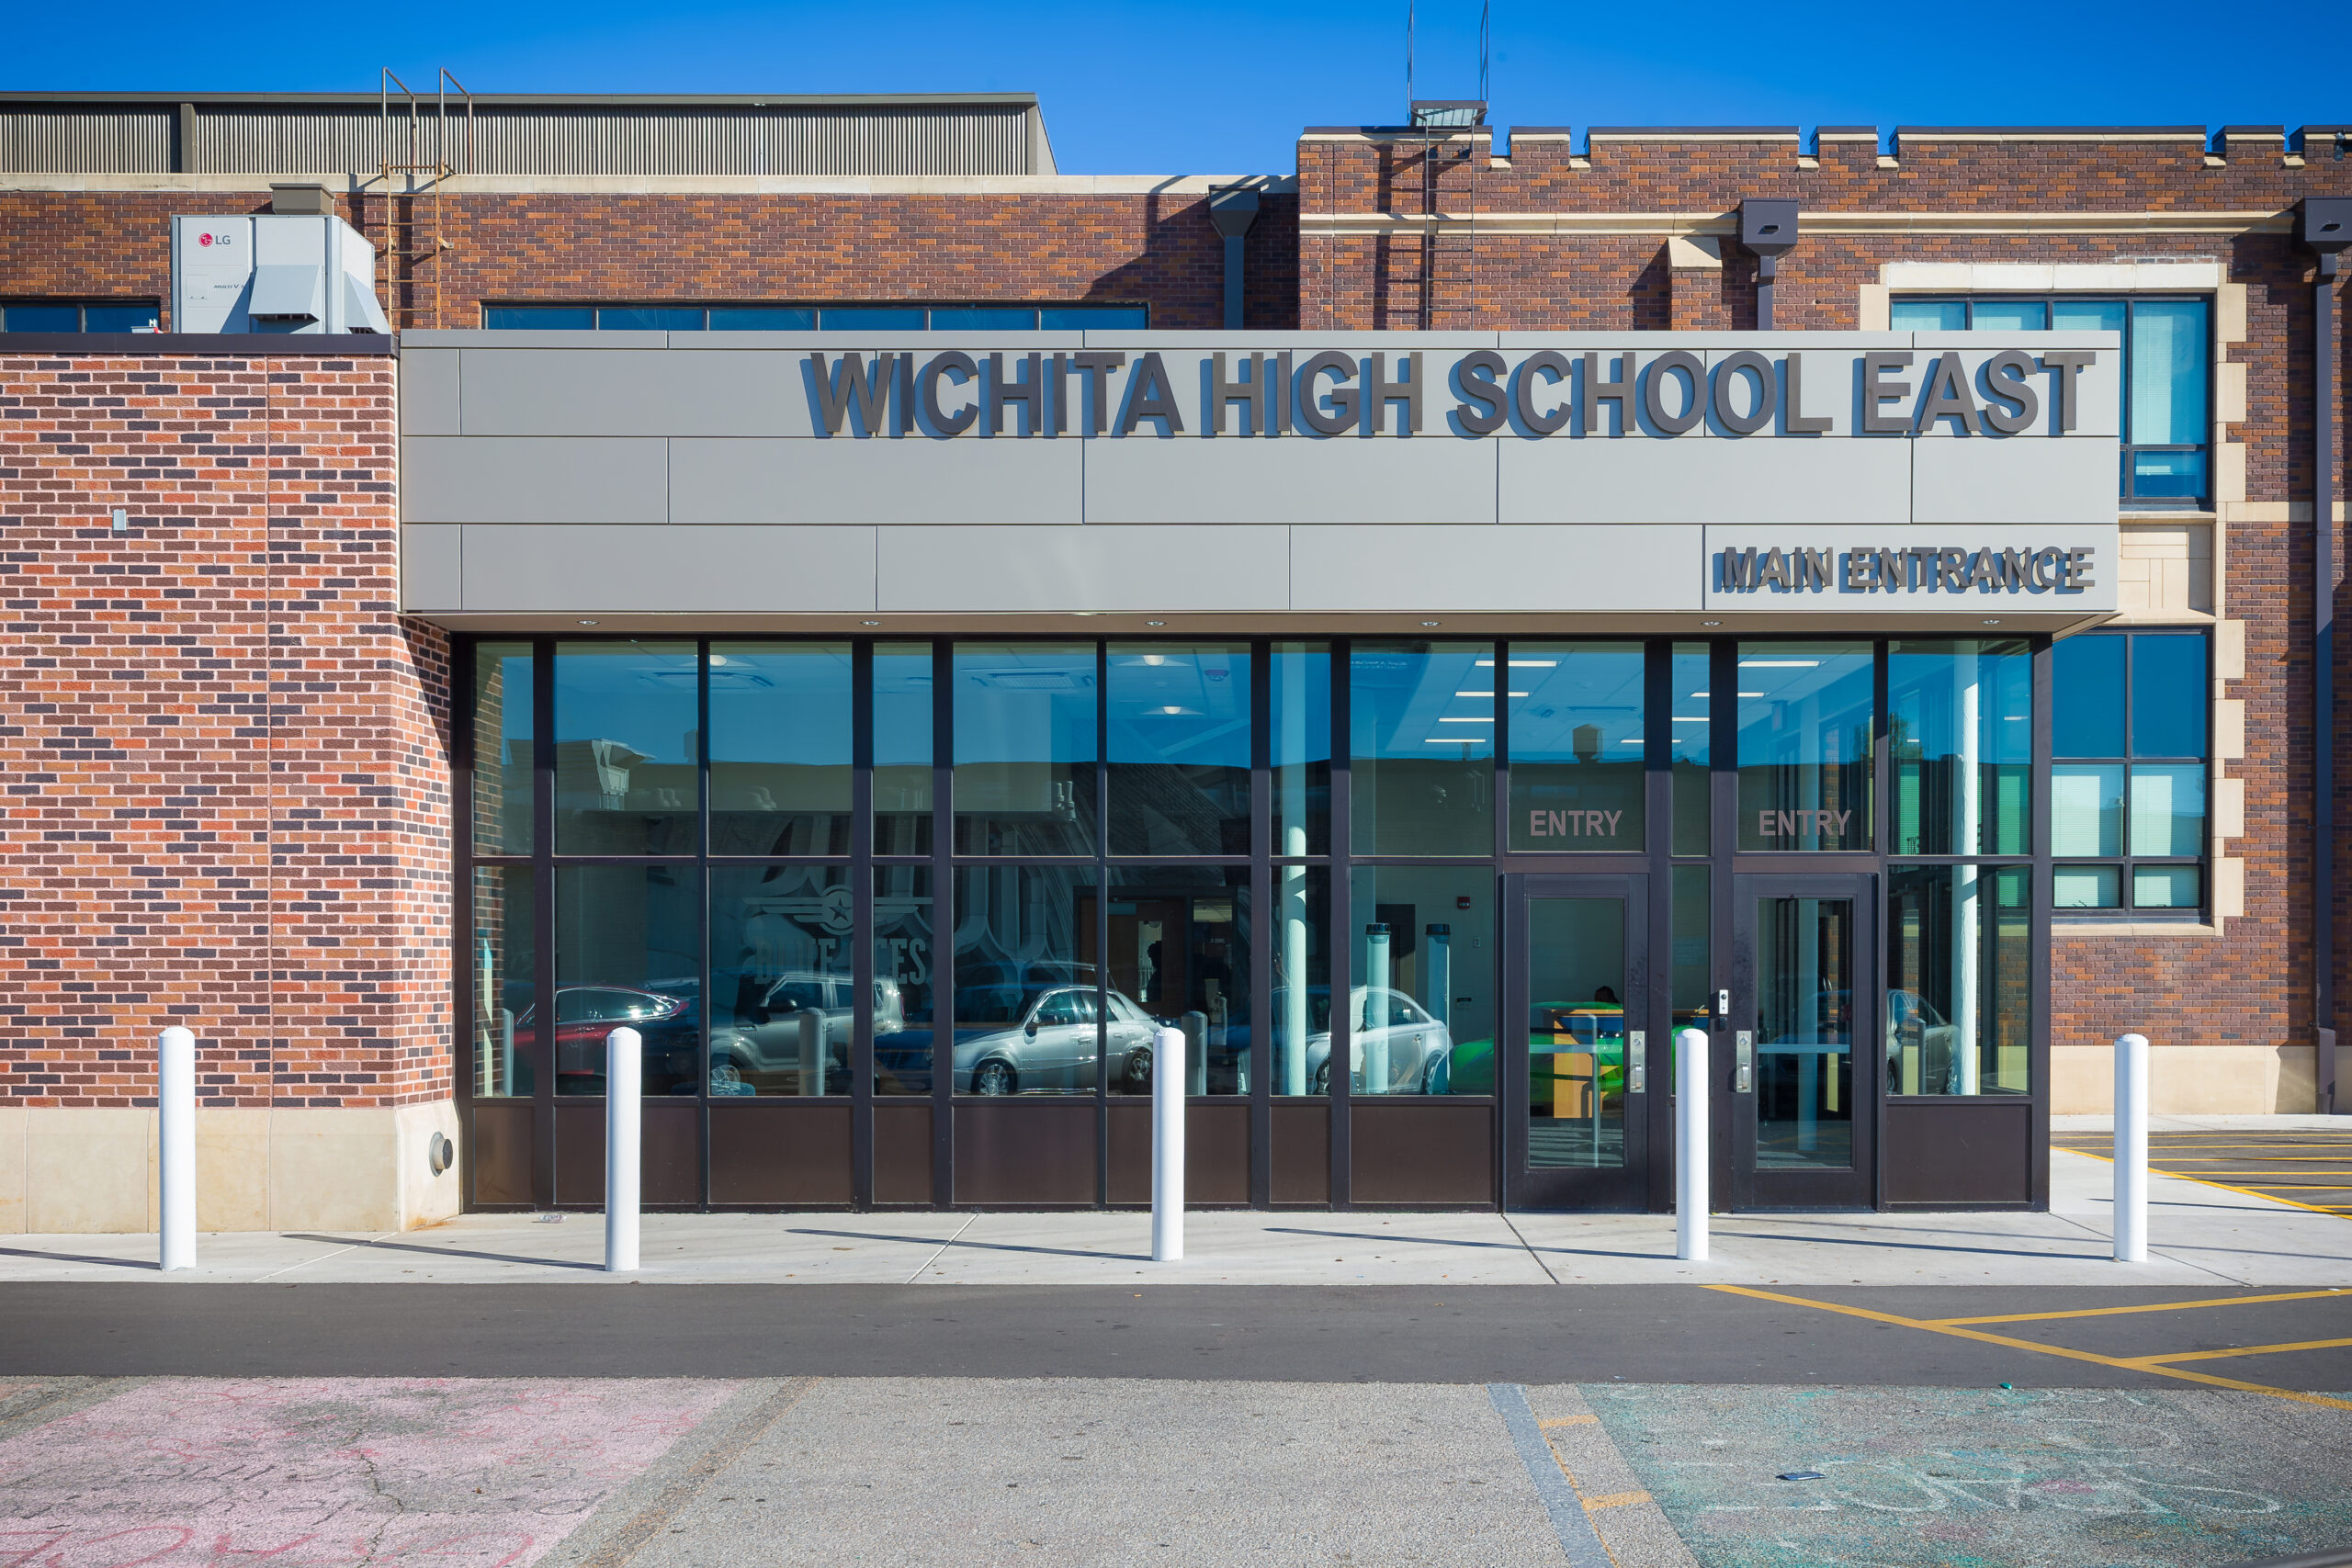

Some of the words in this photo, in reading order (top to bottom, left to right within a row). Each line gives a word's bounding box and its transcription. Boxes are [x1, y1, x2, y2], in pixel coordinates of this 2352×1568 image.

[215, 235, 231, 245] LG
[809, 350, 1185, 435] WICHITA
[1212, 350, 1423, 435] HIGH
[1456, 350, 1833, 435] SCHOOL
[1864, 350, 2097, 435] EAST
[1724, 547, 1834, 587] MAIN
[1850, 547, 2096, 588] ENTRANCE
[1530, 810, 1623, 837] ENTRY
[1758, 810, 1851, 837] ENTRY
